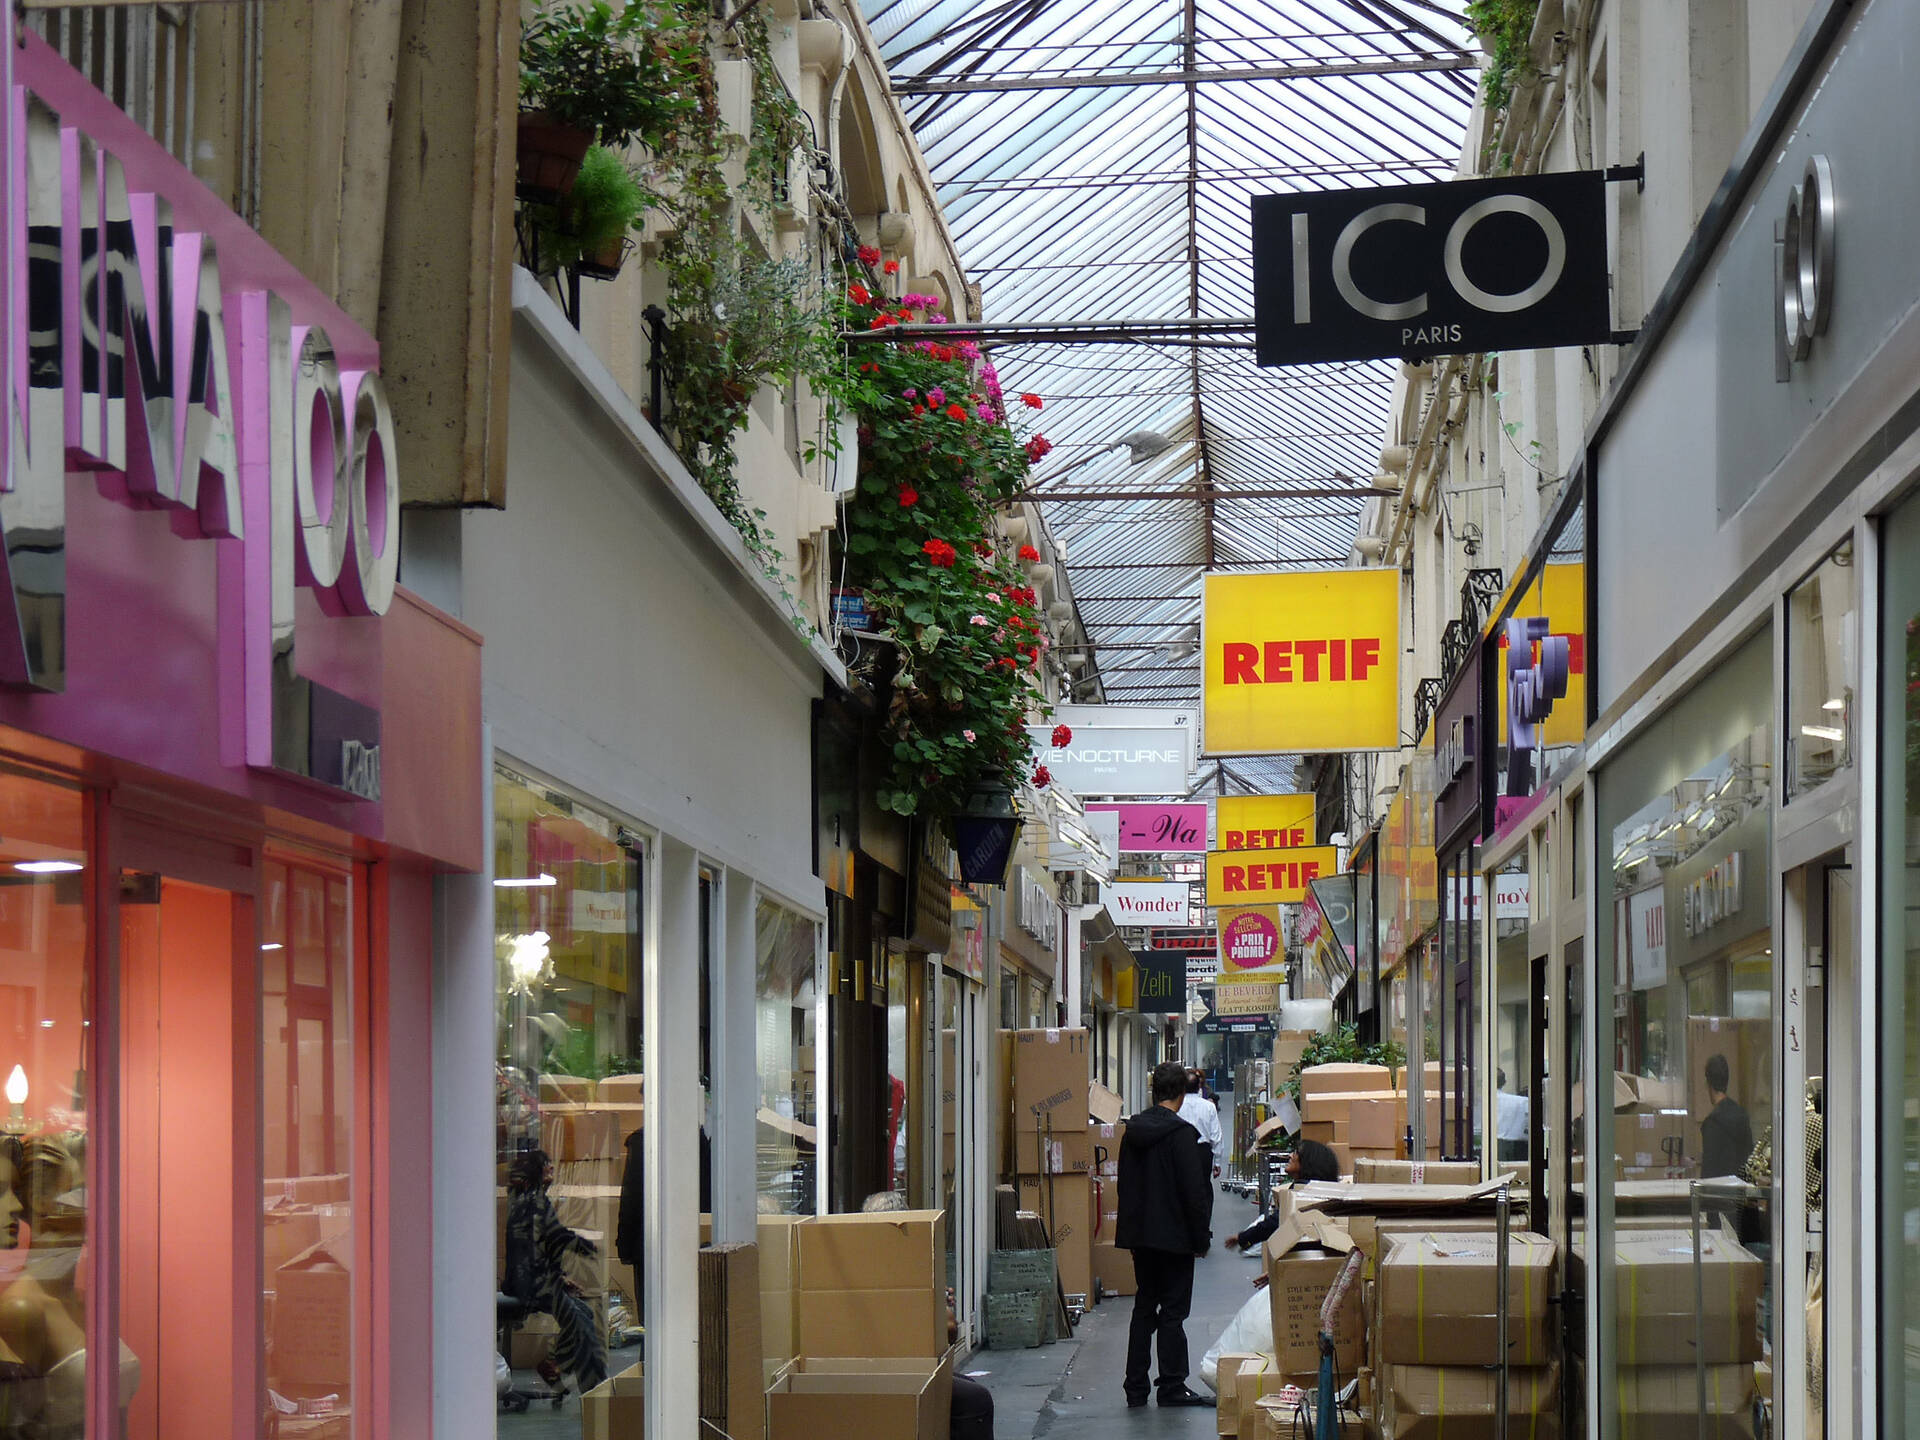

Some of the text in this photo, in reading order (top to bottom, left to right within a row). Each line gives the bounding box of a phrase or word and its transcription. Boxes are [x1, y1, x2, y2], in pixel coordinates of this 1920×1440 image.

[1291, 194, 1567, 325] ICO
[1401, 324, 1463, 347] PARIS
[1223, 638, 1380, 685] RETIF
[1066, 749, 1181, 763] NOCTURNE
[1225, 828, 1305, 850] RETIF
[1222, 861, 1320, 893] RETIF
[1117, 896, 1183, 913] Wonder
[1241, 933, 1265, 946] PRIX
[1231, 946, 1265, 959] PROMO
[1218, 984, 1276, 998] LE BEVERLY
